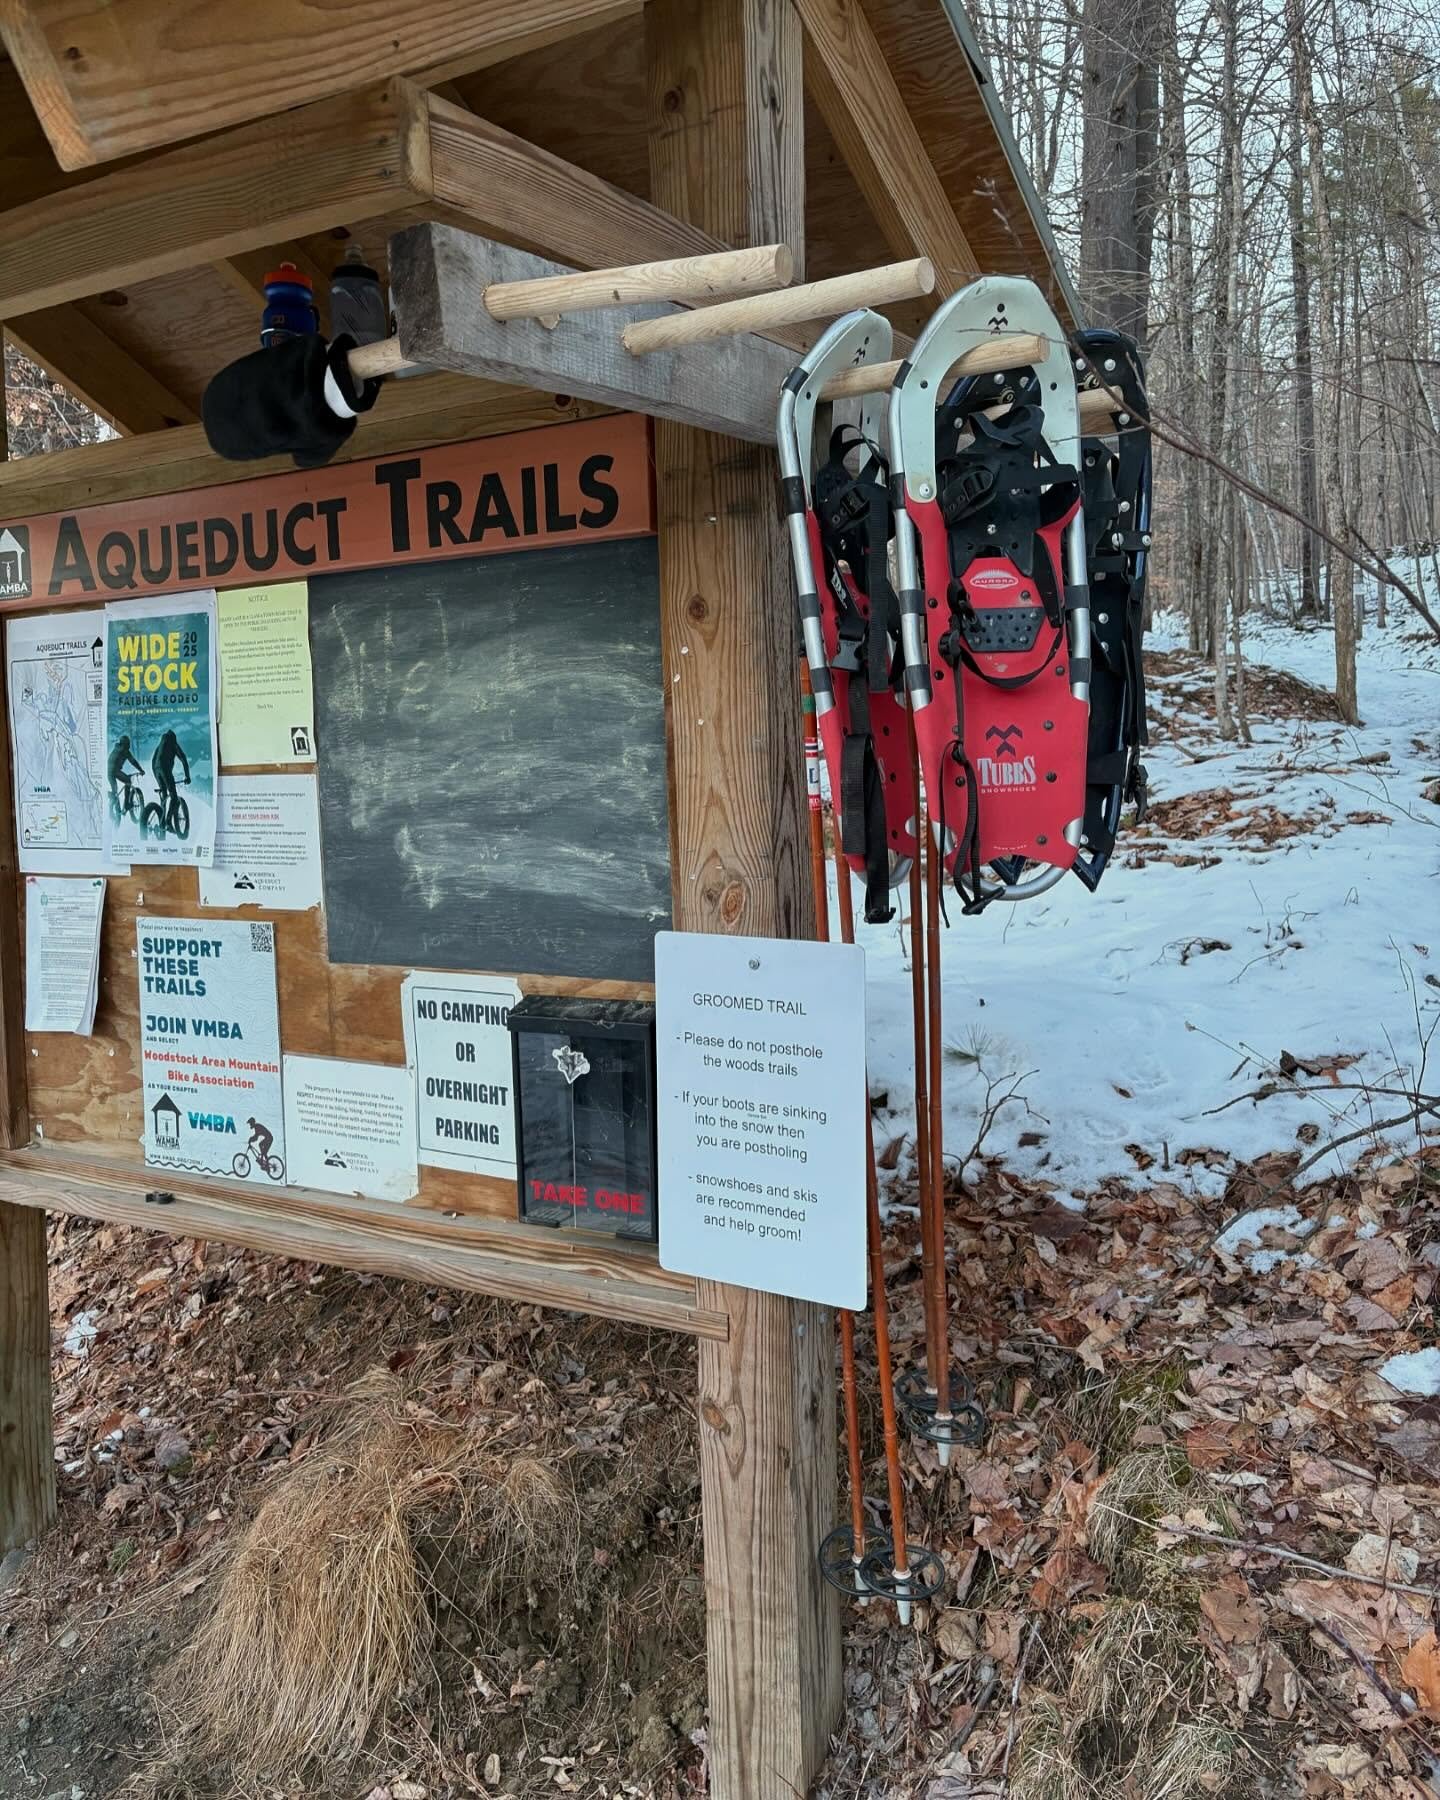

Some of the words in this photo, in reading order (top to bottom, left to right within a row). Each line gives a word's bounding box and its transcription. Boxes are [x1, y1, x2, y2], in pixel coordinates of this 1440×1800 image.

[48, 497, 347, 595] AQUEDUCT
[375, 454, 619, 552] TRAILS
[0, 582, 27, 595] AMBA
[36, 642, 65, 653] AQUEDUCT
[66, 640, 88, 650] TRAILS
[117, 632, 180, 662] WIDE
[183, 631, 198, 644] 20
[183, 645, 198, 657] 25
[117, 662, 198, 693] STOCK
[162, 693, 199, 704] RODEO
[976, 755, 1037, 786] TUBBS
[143, 937, 222, 958] SUPPORT
[143, 957, 199, 976] THESE
[144, 976, 206, 997] TRAILS
[417, 1000, 438, 1020] NO
[693, 993, 763, 1011] GROOMED
[767, 1000, 807, 1015] TRAIL
[146, 1015, 187, 1034] JOIN
[192, 1019, 243, 1040] VMBA
[146, 1036, 157, 1044] AND
[158, 1037, 179, 1045] SELECT
[684, 1031, 724, 1047] Please
[728, 1036, 743, 1049] do
[746, 1040, 766, 1053] not
[770, 1043, 823, 1059] posthole
[144, 1050, 199, 1064] Woodstock
[201, 1055, 226, 1068] Area
[228, 1058, 279, 1073] Mountain
[456, 1042, 476, 1063] OR
[703, 1054, 722, 1068] the
[725, 1058, 764, 1073] woods
[768, 1061, 798, 1077] trails
[168, 1070, 190, 1082] Bike
[192, 1073, 255, 1089] Association
[173, 1085, 198, 1094] CHAPTER
[426, 1077, 509, 1106] OVERNIGHT
[682, 1090, 690, 1103] If
[693, 1094, 719, 1107] your
[722, 1096, 755, 1112] boots
[759, 1103, 779, 1115] are
[783, 1105, 827, 1125] sinking
[187, 1111, 237, 1134] VMBA
[436, 1117, 500, 1145] PARKING
[695, 1112, 716, 1127] into
[720, 1116, 738, 1130] the
[742, 1121, 774, 1135] snow
[777, 1124, 805, 1140] then
[696, 1134, 718, 1147] you
[721, 1138, 741, 1150] are
[744, 1141, 808, 1163] postholing
[530, 1180, 588, 1206] TAKE
[594, 1190, 646, 1214] ONE
[696, 1174, 763, 1194] snowshoes
[766, 1185, 790, 1198] and
[793, 1189, 818, 1203] skis
[696, 1193, 715, 1206] are
[718, 1196, 806, 1222] recommended
[704, 1213, 726, 1227] and
[729, 1217, 755, 1235] help
[758, 1224, 801, 1242] groom!
